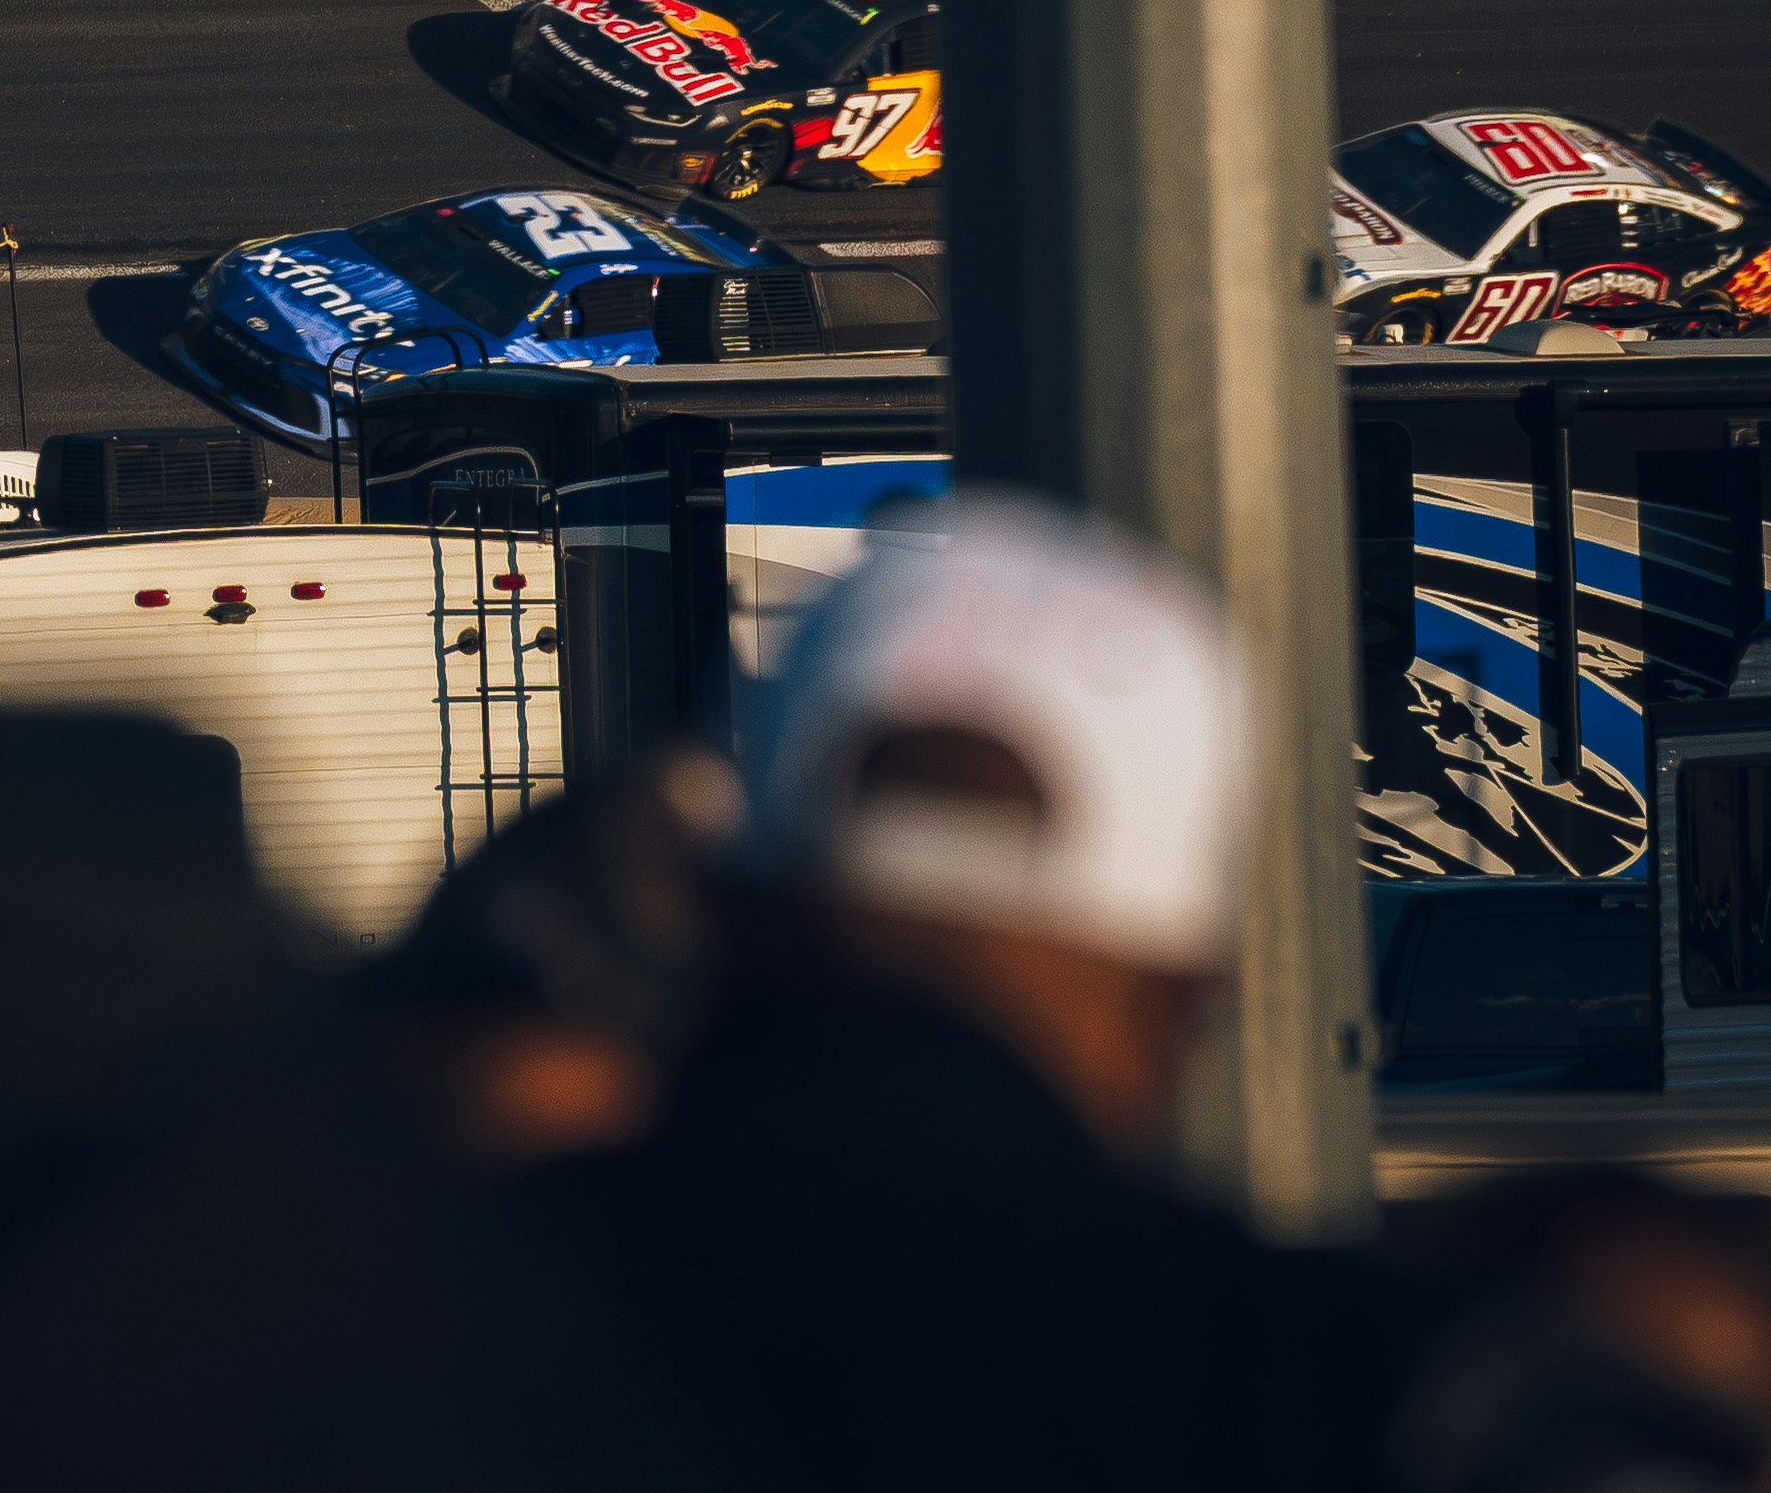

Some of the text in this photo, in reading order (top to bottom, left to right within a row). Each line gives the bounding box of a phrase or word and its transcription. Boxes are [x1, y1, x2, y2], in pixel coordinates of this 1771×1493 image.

[624, 31, 746, 106] Bull
[818, 91, 920, 160] 97
[1465, 119, 1595, 180] 60
[493, 193, 634, 260] 23
[1446, 271, 1557, 344] 60
